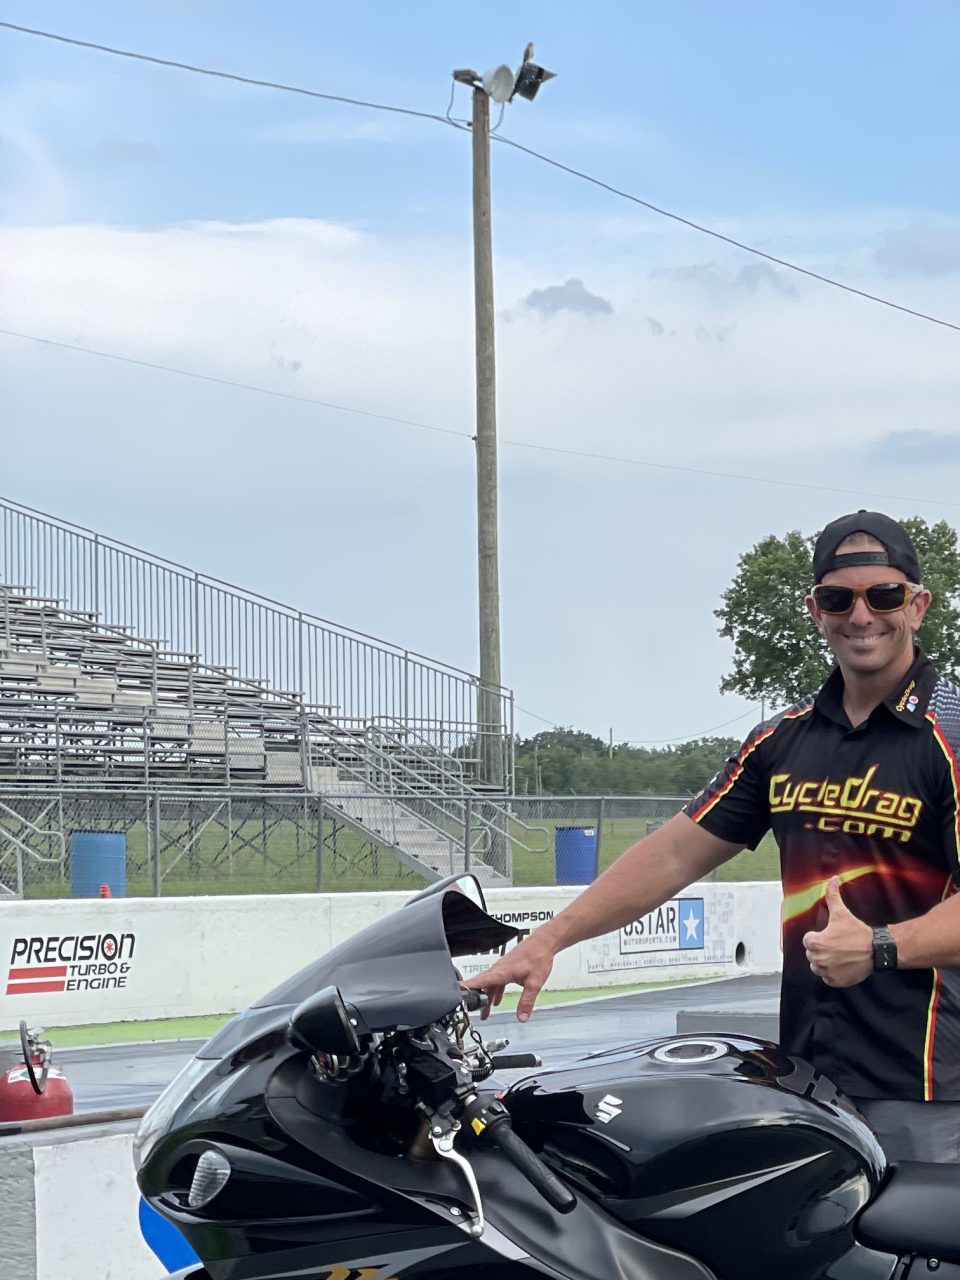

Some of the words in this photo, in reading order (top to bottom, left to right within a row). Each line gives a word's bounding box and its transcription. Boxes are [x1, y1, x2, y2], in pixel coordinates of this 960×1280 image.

[10, 933, 136, 965] PRECISION
[69, 962, 118, 977] TURBO
[120, 962, 131, 973] &
[66, 976, 127, 991] ENGINE
